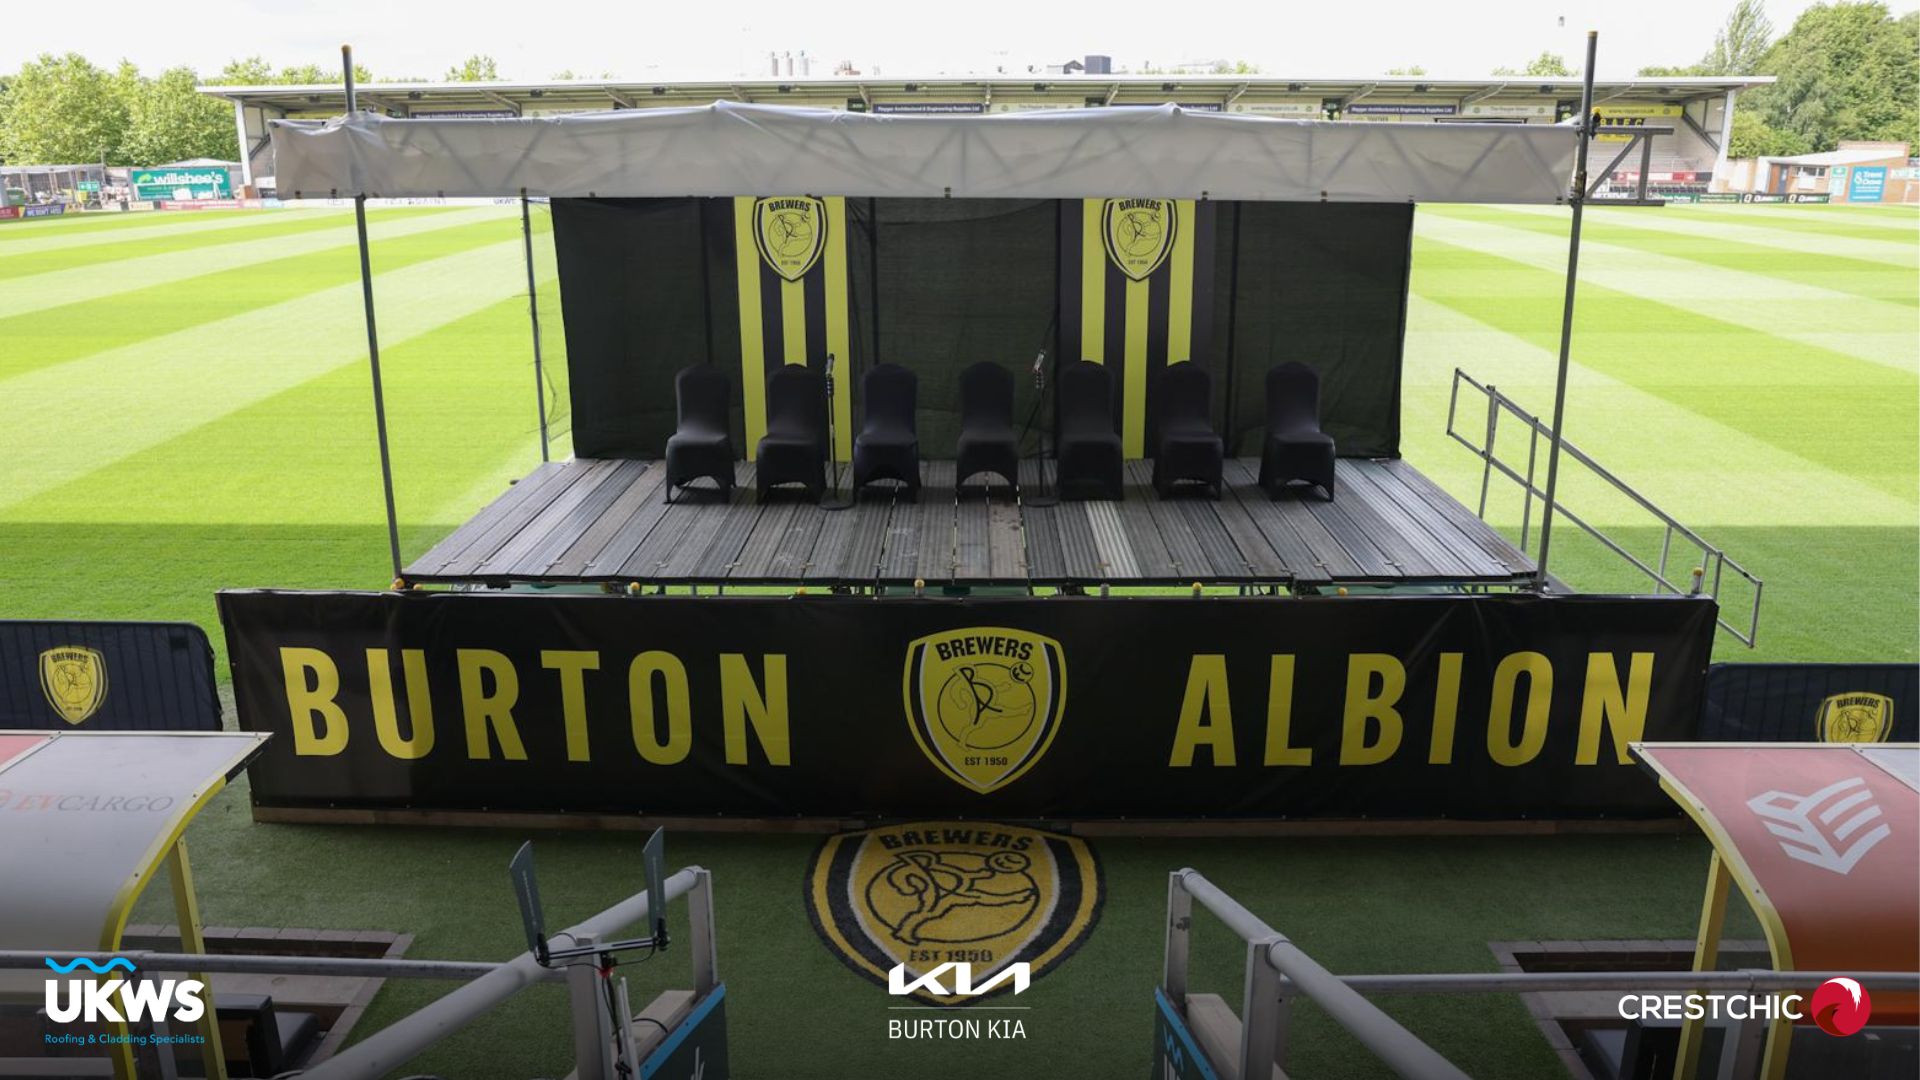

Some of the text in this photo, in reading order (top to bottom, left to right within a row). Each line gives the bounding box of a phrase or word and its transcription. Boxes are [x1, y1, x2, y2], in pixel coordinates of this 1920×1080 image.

[153, 171, 223, 184] willsbee's
[769, 199, 812, 212] BREWERS
[1119, 199, 1162, 211] BREWERS
[935, 636, 1033, 662] BREWERS
[279, 647, 1655, 766] BURTON ALBION
[1836, 697, 1880, 709] BREWERS
[964, 757, 1008, 766] EST 1950
[878, 829, 1033, 851] BREWERS
[908, 949, 993, 963] EST 1950
